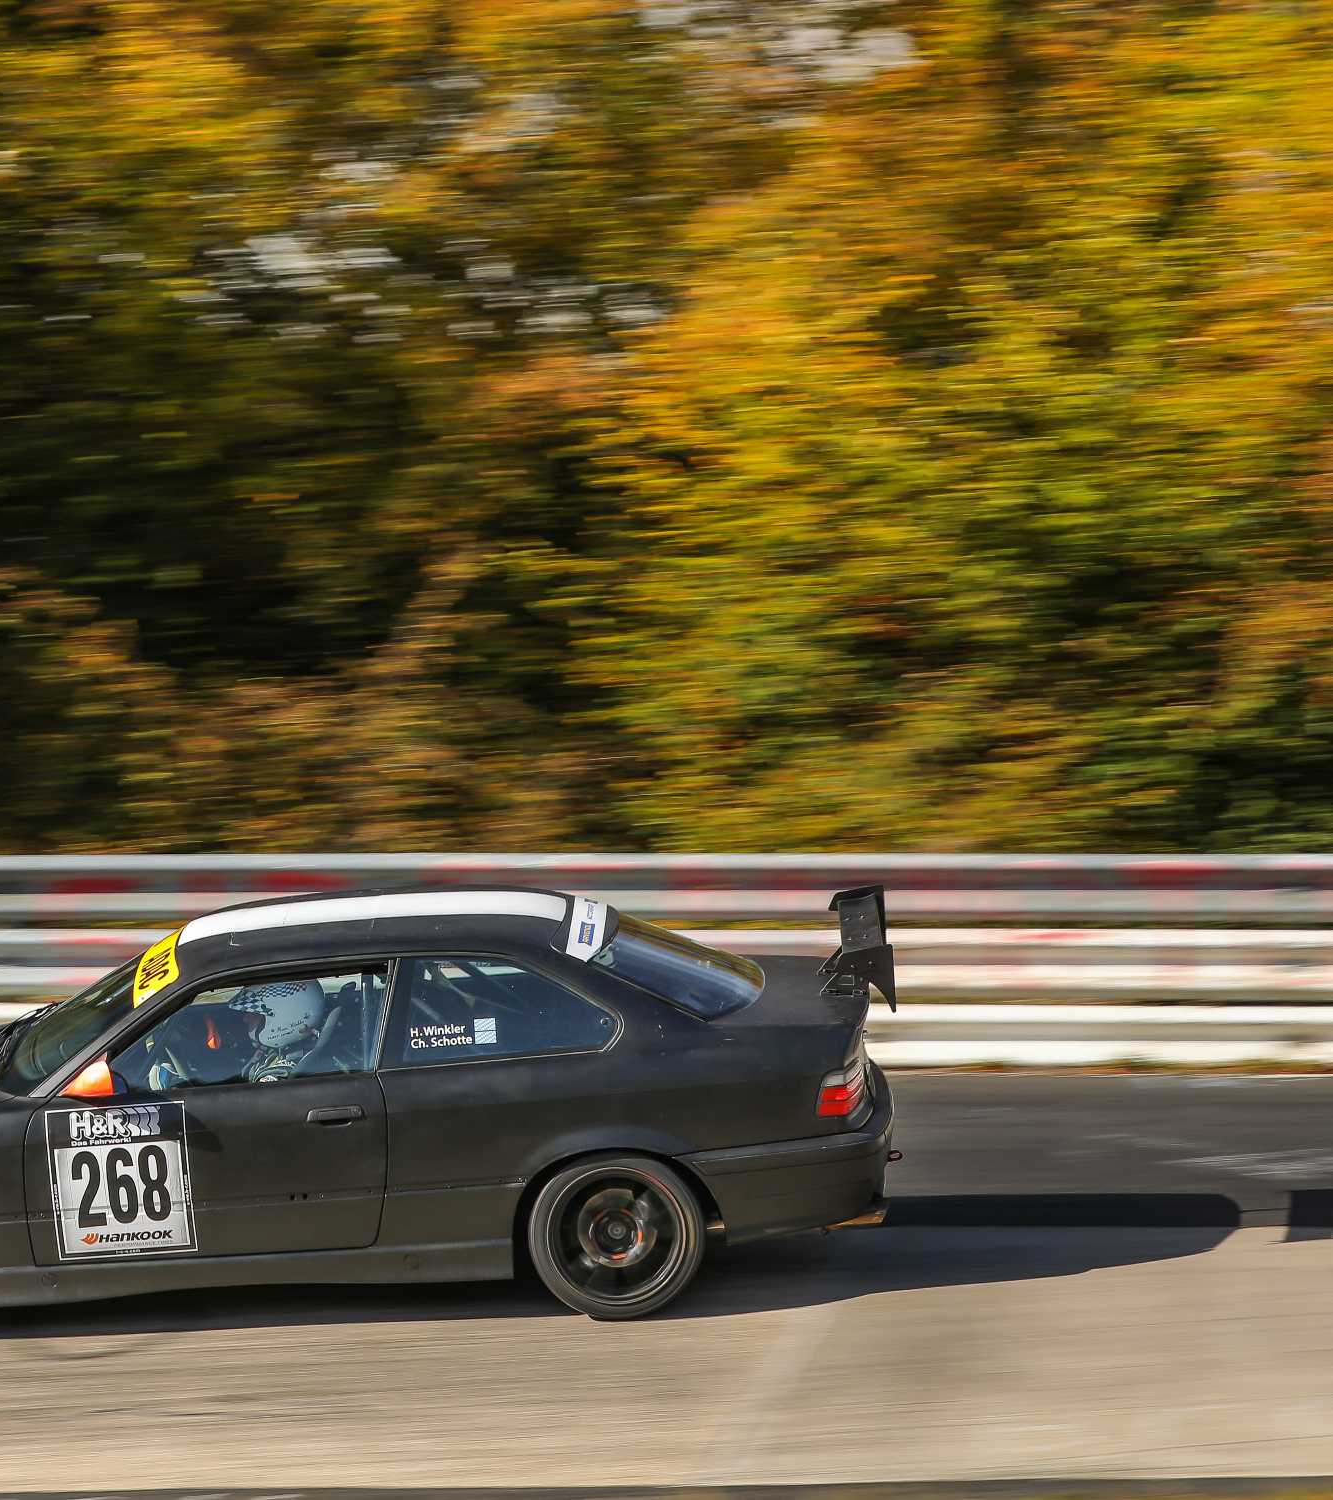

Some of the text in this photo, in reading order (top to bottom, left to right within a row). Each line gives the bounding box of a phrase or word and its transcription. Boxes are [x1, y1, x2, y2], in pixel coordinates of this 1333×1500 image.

[410, 1035, 473, 1049] Ch. Schotte
[71, 1145, 171, 1228] 268
